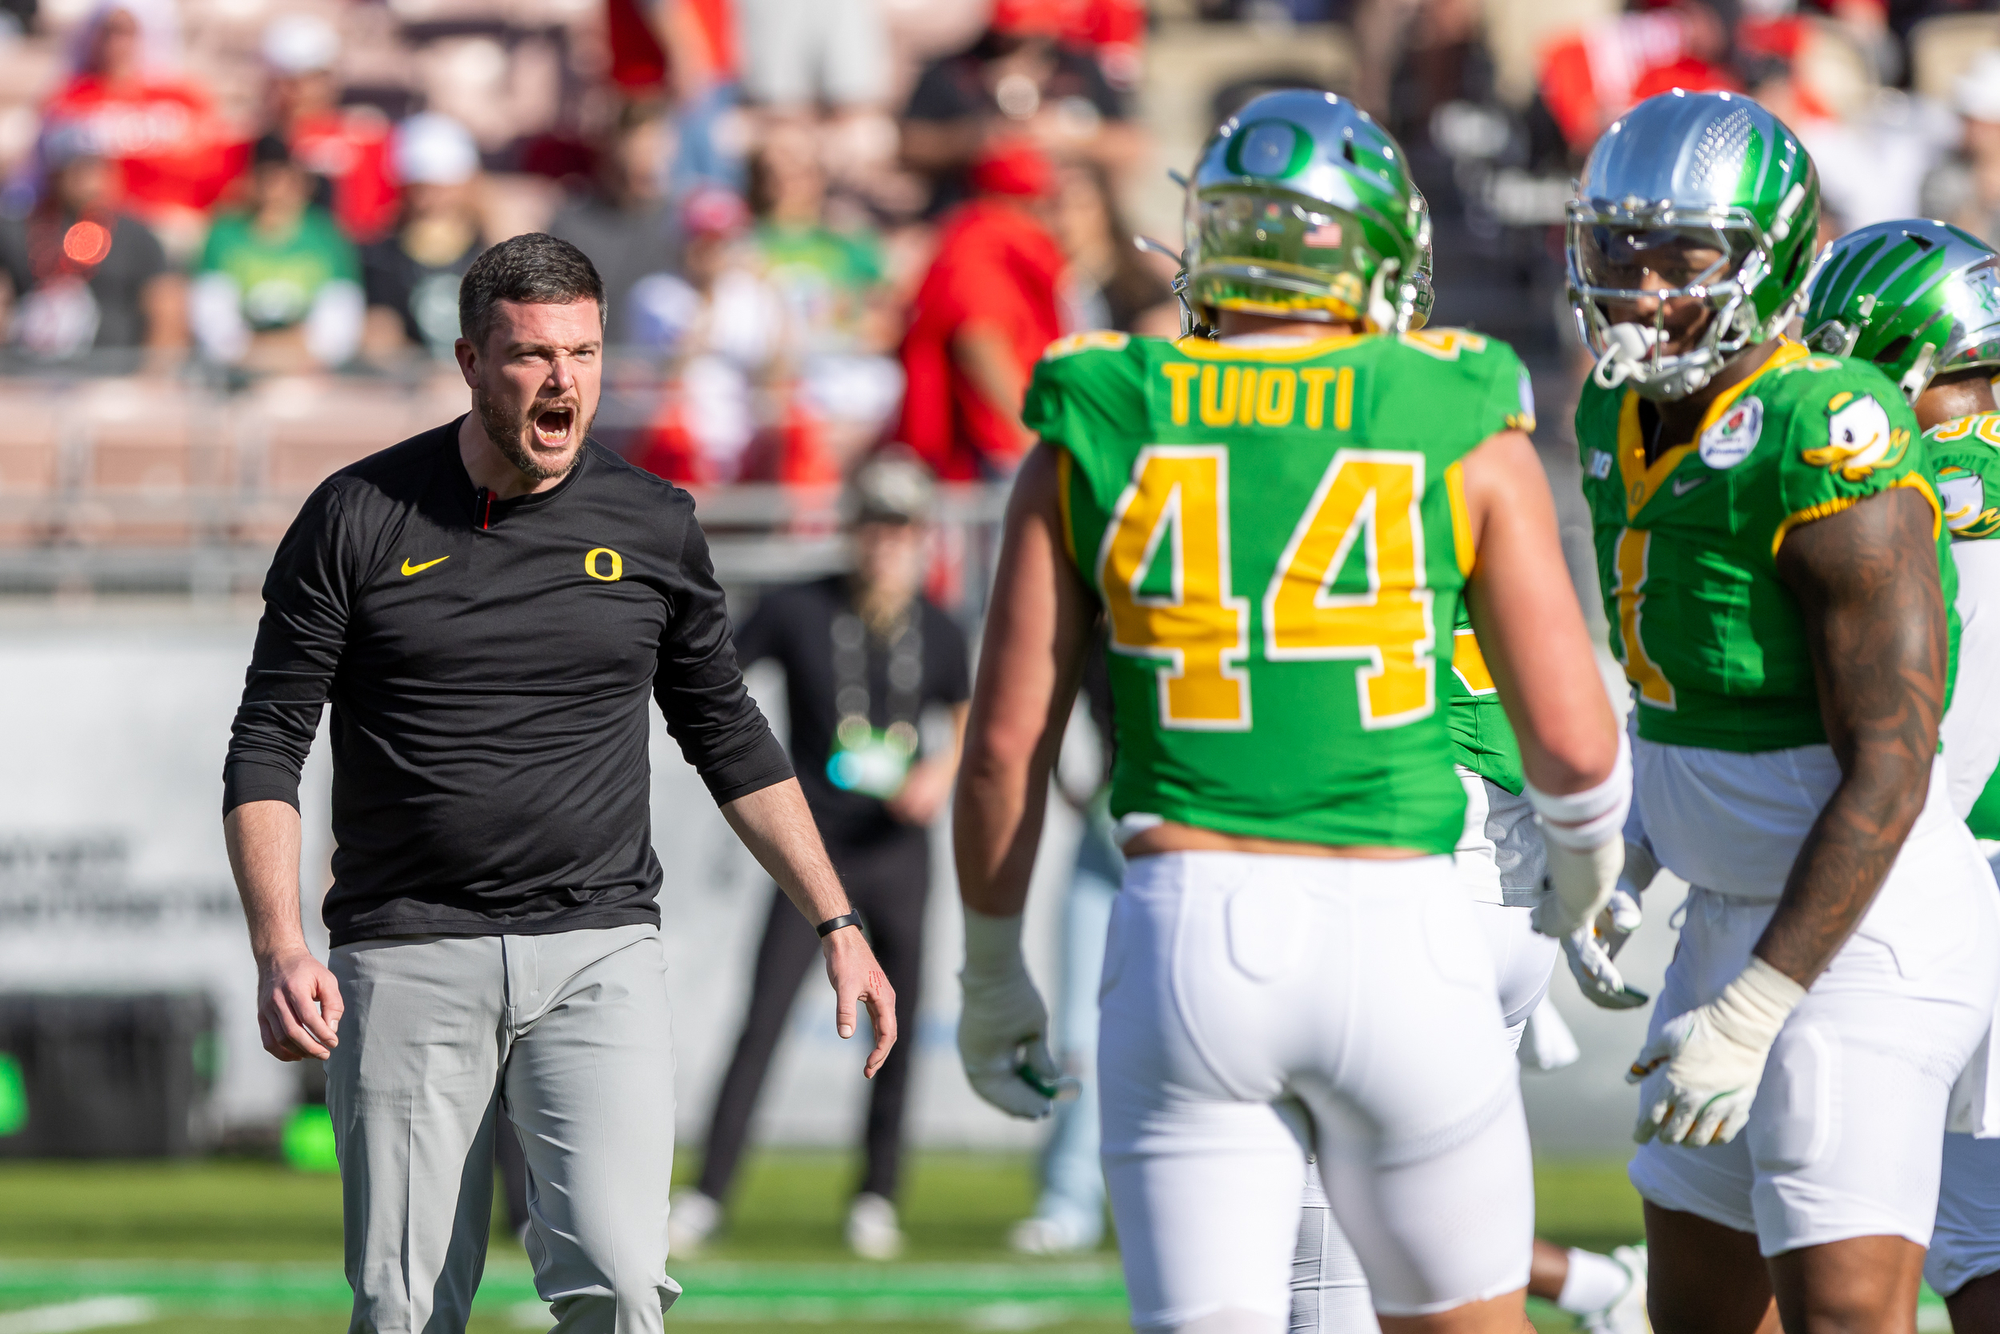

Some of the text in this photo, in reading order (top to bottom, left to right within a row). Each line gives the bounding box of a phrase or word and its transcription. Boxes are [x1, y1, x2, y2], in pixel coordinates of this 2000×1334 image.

[1161, 362, 1354, 431] TUIOTI
[584, 547, 623, 582] O
[1095, 443, 1435, 732] 44
[1610, 526, 1677, 711] 1
